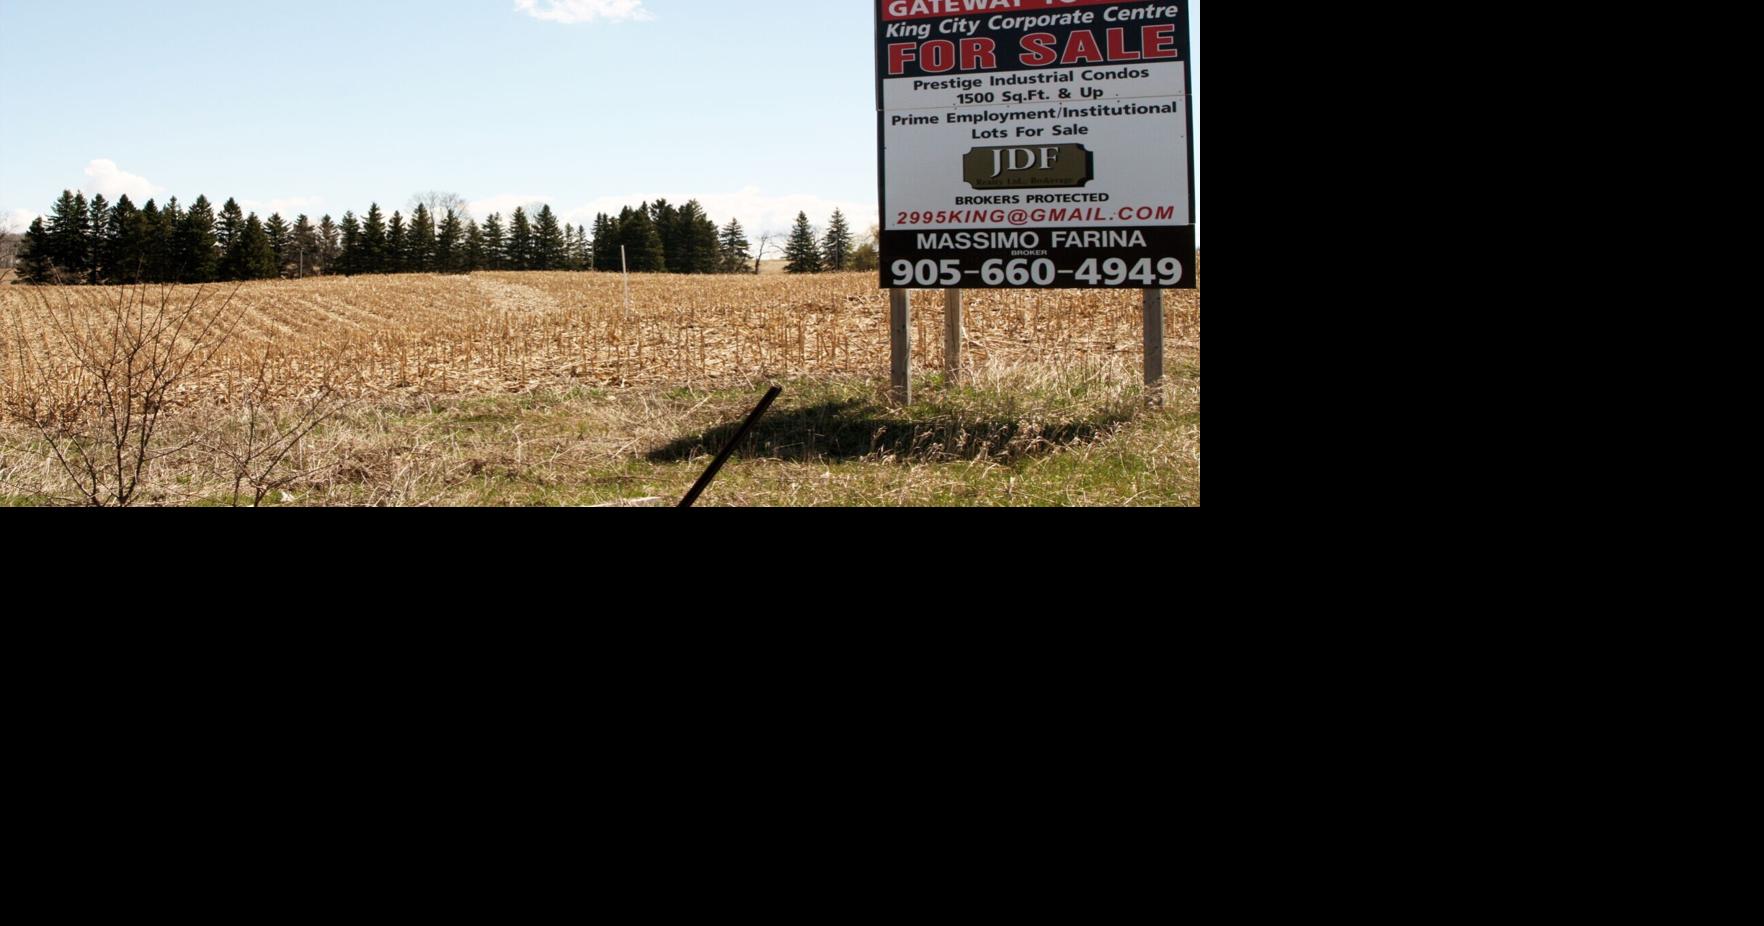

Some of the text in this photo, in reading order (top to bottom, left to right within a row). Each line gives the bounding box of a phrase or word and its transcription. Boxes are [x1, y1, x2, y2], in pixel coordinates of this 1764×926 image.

[885, 3, 1178, 39] King City Corporate Centre
[887, 23, 1178, 75] FOR SALE
[913, 67, 1150, 91] Prestige Industrial Condos
[956, 86, 1104, 104] 1500 Sq.Ft. & Up
[891, 101, 1177, 126] Prime Employment/Institutional
[971, 124, 1089, 139] Lots For Sale
[990, 146, 1060, 178] JDF
[955, 192, 1110, 206] BROKERS PROTECTED
[897, 205, 1175, 226] 2995KING@GMAIL.COM
[916, 230, 1147, 250] MASSIMO FARINA
[890, 257, 1183, 286] 905-660-4949
